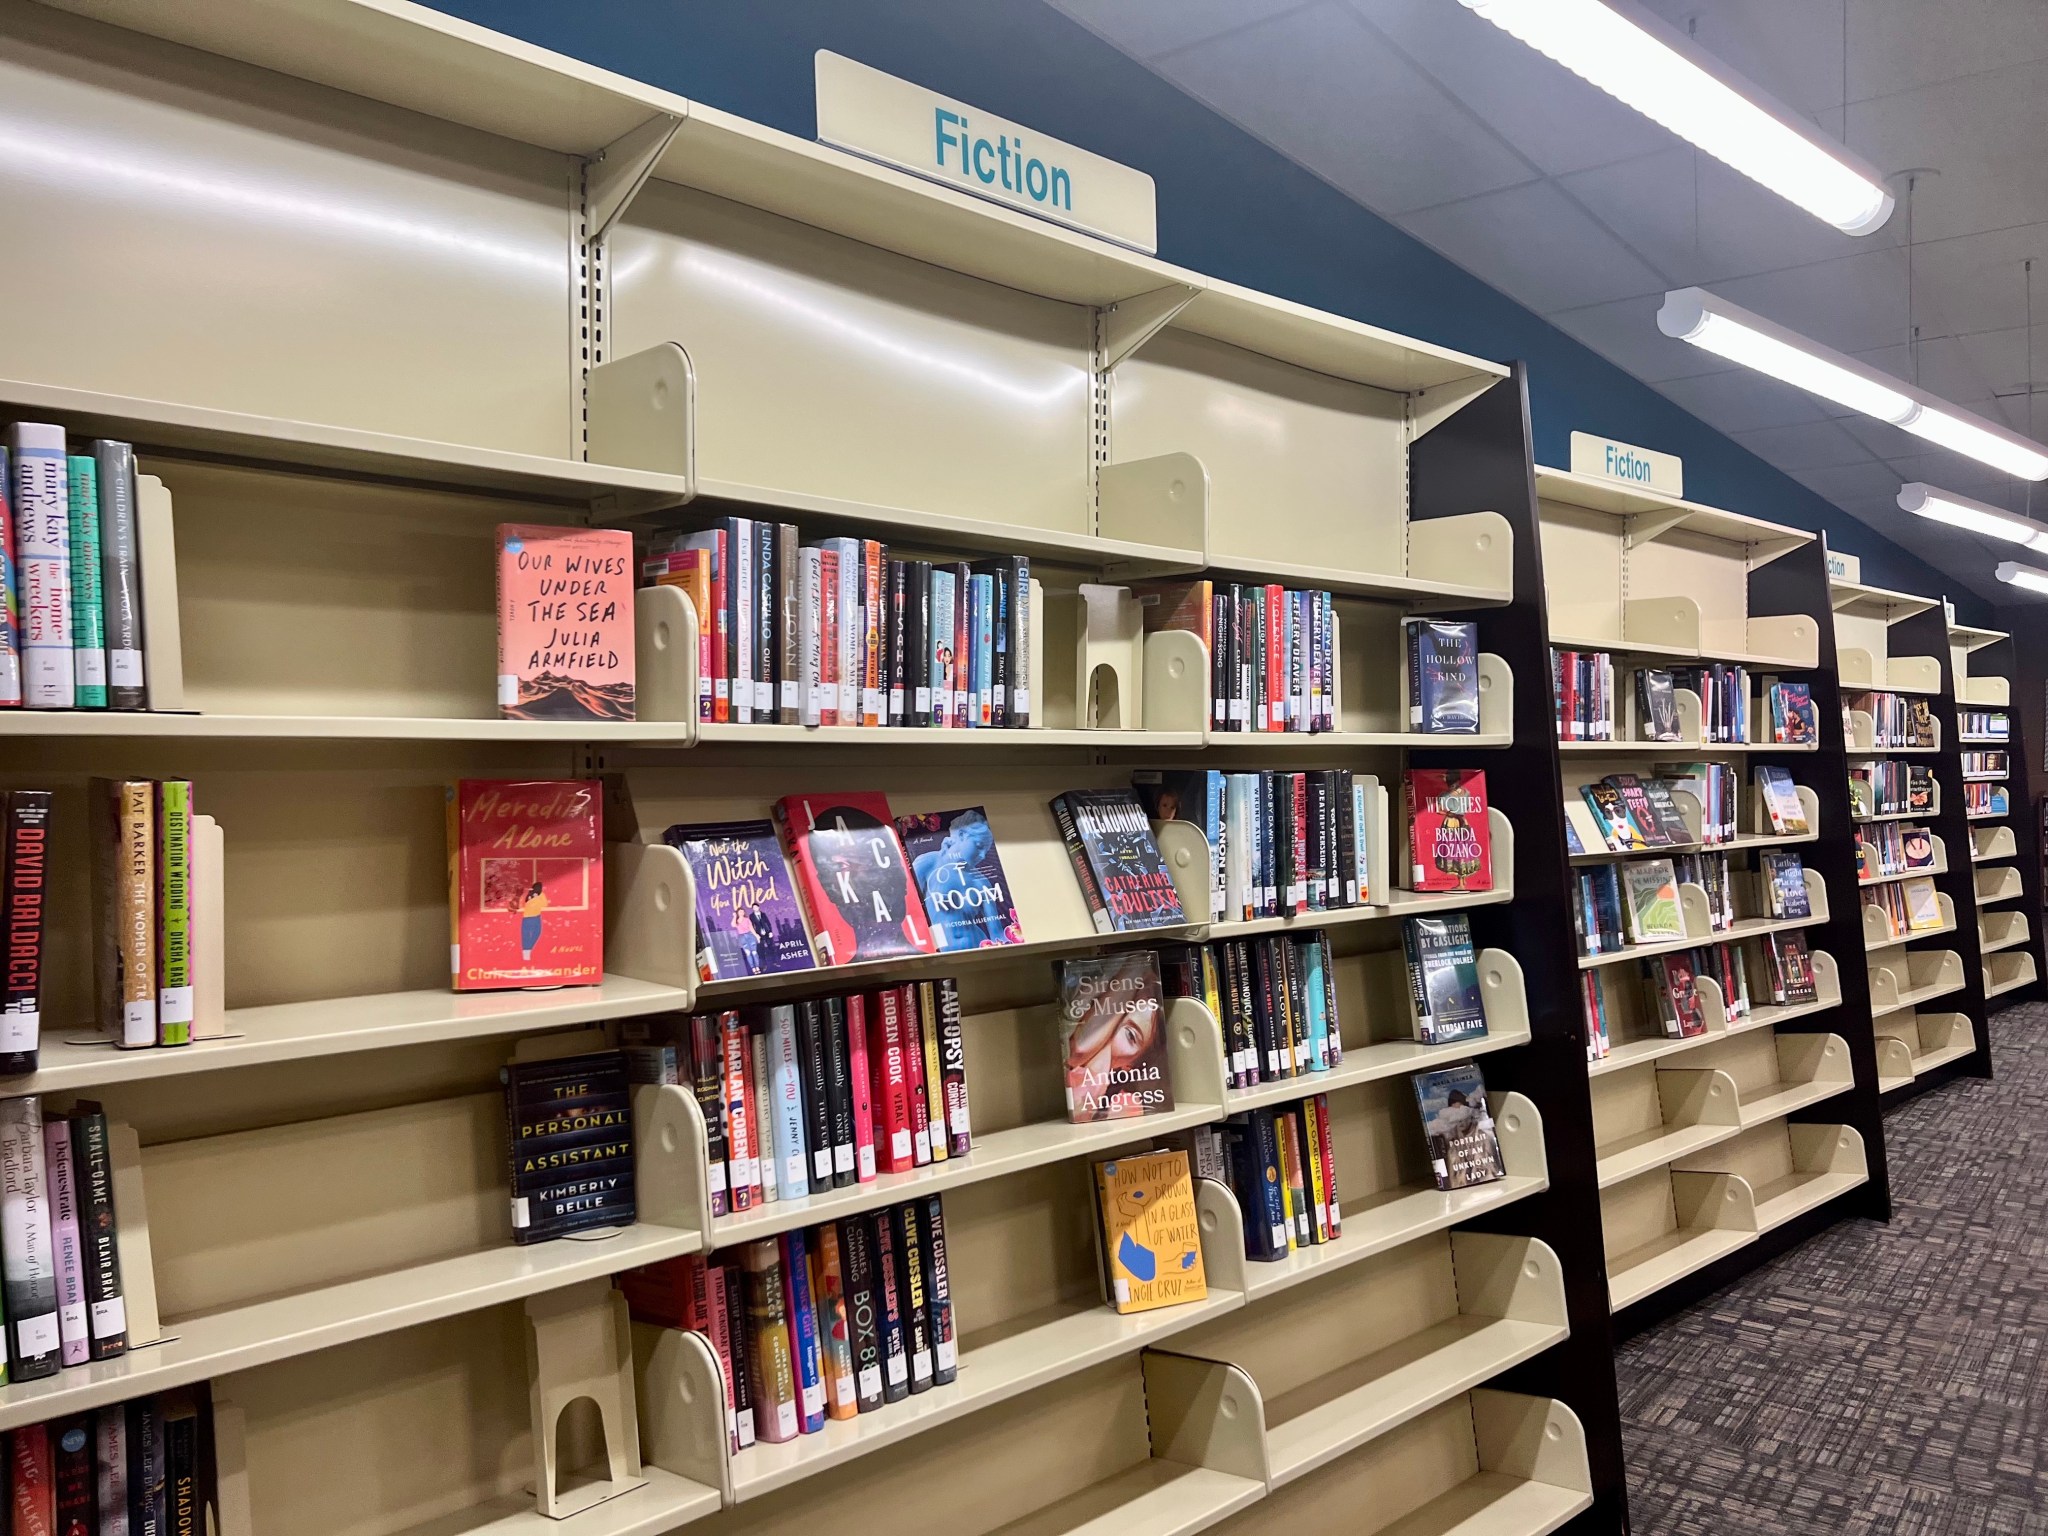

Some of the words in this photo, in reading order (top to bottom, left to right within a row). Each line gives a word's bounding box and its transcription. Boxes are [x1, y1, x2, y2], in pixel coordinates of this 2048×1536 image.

[935, 107, 1071, 211] Fiction
[1606, 445, 1651, 483] Fiction
[41, 462, 58, 510] mary
[21, 464, 42, 543] andrews
[43, 515, 65, 547] kay
[518, 551, 552, 571] OUR
[566, 555, 626, 575] WIVES
[762, 529, 772, 570] LINDA
[1828, 556, 1845, 577] ction
[29, 563, 48, 641] wreckers
[540, 579, 607, 596] UNDER
[528, 601, 567, 622] THE
[576, 601, 616, 622] SEA
[544, 628, 600, 649] JULIA
[1272, 595, 1280, 660] VIOLENCE
[1438, 638, 1462, 648] THE
[528, 650, 619, 669] ARMFIELD
[1313, 644, 1322, 685] DEAVER
[1426, 655, 1475, 665] HOLLOW
[1438, 672, 1466, 682] KIND
[132, 792, 144, 815] PAT
[467, 791, 589, 822] Meredith
[1425, 796, 1482, 813] WITCHES
[1077, 804, 1150, 834] RECKONING
[132, 822, 145, 875] BARKER
[169, 811, 184, 868] DESTINATION
[493, 825, 574, 849] Alone
[1435, 828, 1477, 842] BRENDA
[14, 829, 45, 888] DAVID
[1432, 843, 1482, 858] LOZANO
[707, 850, 770, 890] Witch
[1075, 855, 1093, 895] CATHERINE
[1105, 873, 1170, 892] CATHERINE
[134, 882, 146, 904] THE
[170, 871, 184, 910] WEDDING
[732, 876, 779, 911] Wed
[931, 883, 1004, 912] ROOM
[1110, 889, 1181, 915] COULTER
[8, 895, 41, 990] BALDACCI
[134, 911, 146, 957] WOMEN
[170, 932, 184, 963] DIKSHA
[779, 940, 804, 949] APRIL
[1420, 938, 1431, 948] BY
[1433, 934, 1469, 947] GASLIGHT
[780, 950, 808, 960] ASHER
[1275, 947, 1284, 992] ATOMIC
[135, 961, 146, 983] OF
[1078, 976, 1145, 995] Sirens
[1093, 997, 1159, 1017] Muses
[1242, 972, 1252, 1016] EVANOVICH
[884, 997, 898, 1043] ROBIN
[941, 990, 964, 1070] AUTOPSY
[783, 1037, 793, 1063] MILES
[834, 1039, 845, 1088] Connolly
[727, 1038, 744, 1101] HARLAN
[814, 1041, 825, 1091] Connolly
[887, 1047, 903, 1085] COOK
[1081, 1063, 1161, 1088] Antonia
[553, 1084, 588, 1099] THE
[785, 1081, 796, 1100] YOU
[1081, 1088, 1165, 1112] Angress
[894, 1092, 905, 1124] VIRAL
[522, 1112, 628, 1139] PERSONAL
[731, 1107, 748, 1159] COBEN
[789, 1116, 799, 1145] JENNY
[1449, 1133, 1487, 1147] PORTRAIT
[88, 1126, 103, 1166] SMALL
[524, 1143, 630, 1172] ASSISTANT
[1307, 1103, 1315, 1127] LISA
[1311, 1130, 1321, 1182] GARDNER
[1114, 1168, 1138, 1187] HOW
[1142, 1162, 1163, 1182] NOT
[1166, 1159, 1182, 1177] TO
[1453, 1155, 1495, 1172] UNKNOWN
[1466, 1170, 1487, 1182] LADY
[25, 1175, 39, 1213] Taylor
[55, 1141, 71, 1221] Defenestrate
[92, 1170, 107, 1205] GAME
[539, 1178, 618, 1201] KIMBERLY
[1155, 1183, 1188, 1200] DROWN
[555, 1196, 604, 1215] BELLE
[1169, 1202, 1194, 1220] GLASS
[904, 1207, 917, 1246] CLIVE
[1153, 1230, 1165, 1246] OF
[1167, 1224, 1197, 1243] WATER
[62, 1236, 75, 1274] RENEE
[98, 1236, 111, 1269] BLAIR
[847, 1227, 859, 1282] CUMMING
[856, 1228, 868, 1275] CHARLES
[908, 1248, 923, 1309] CUSSLER
[933, 1240, 948, 1300] CUSSLER
[1157, 1279, 1182, 1298] CRUZ
[854, 1290, 874, 1342] BOX
